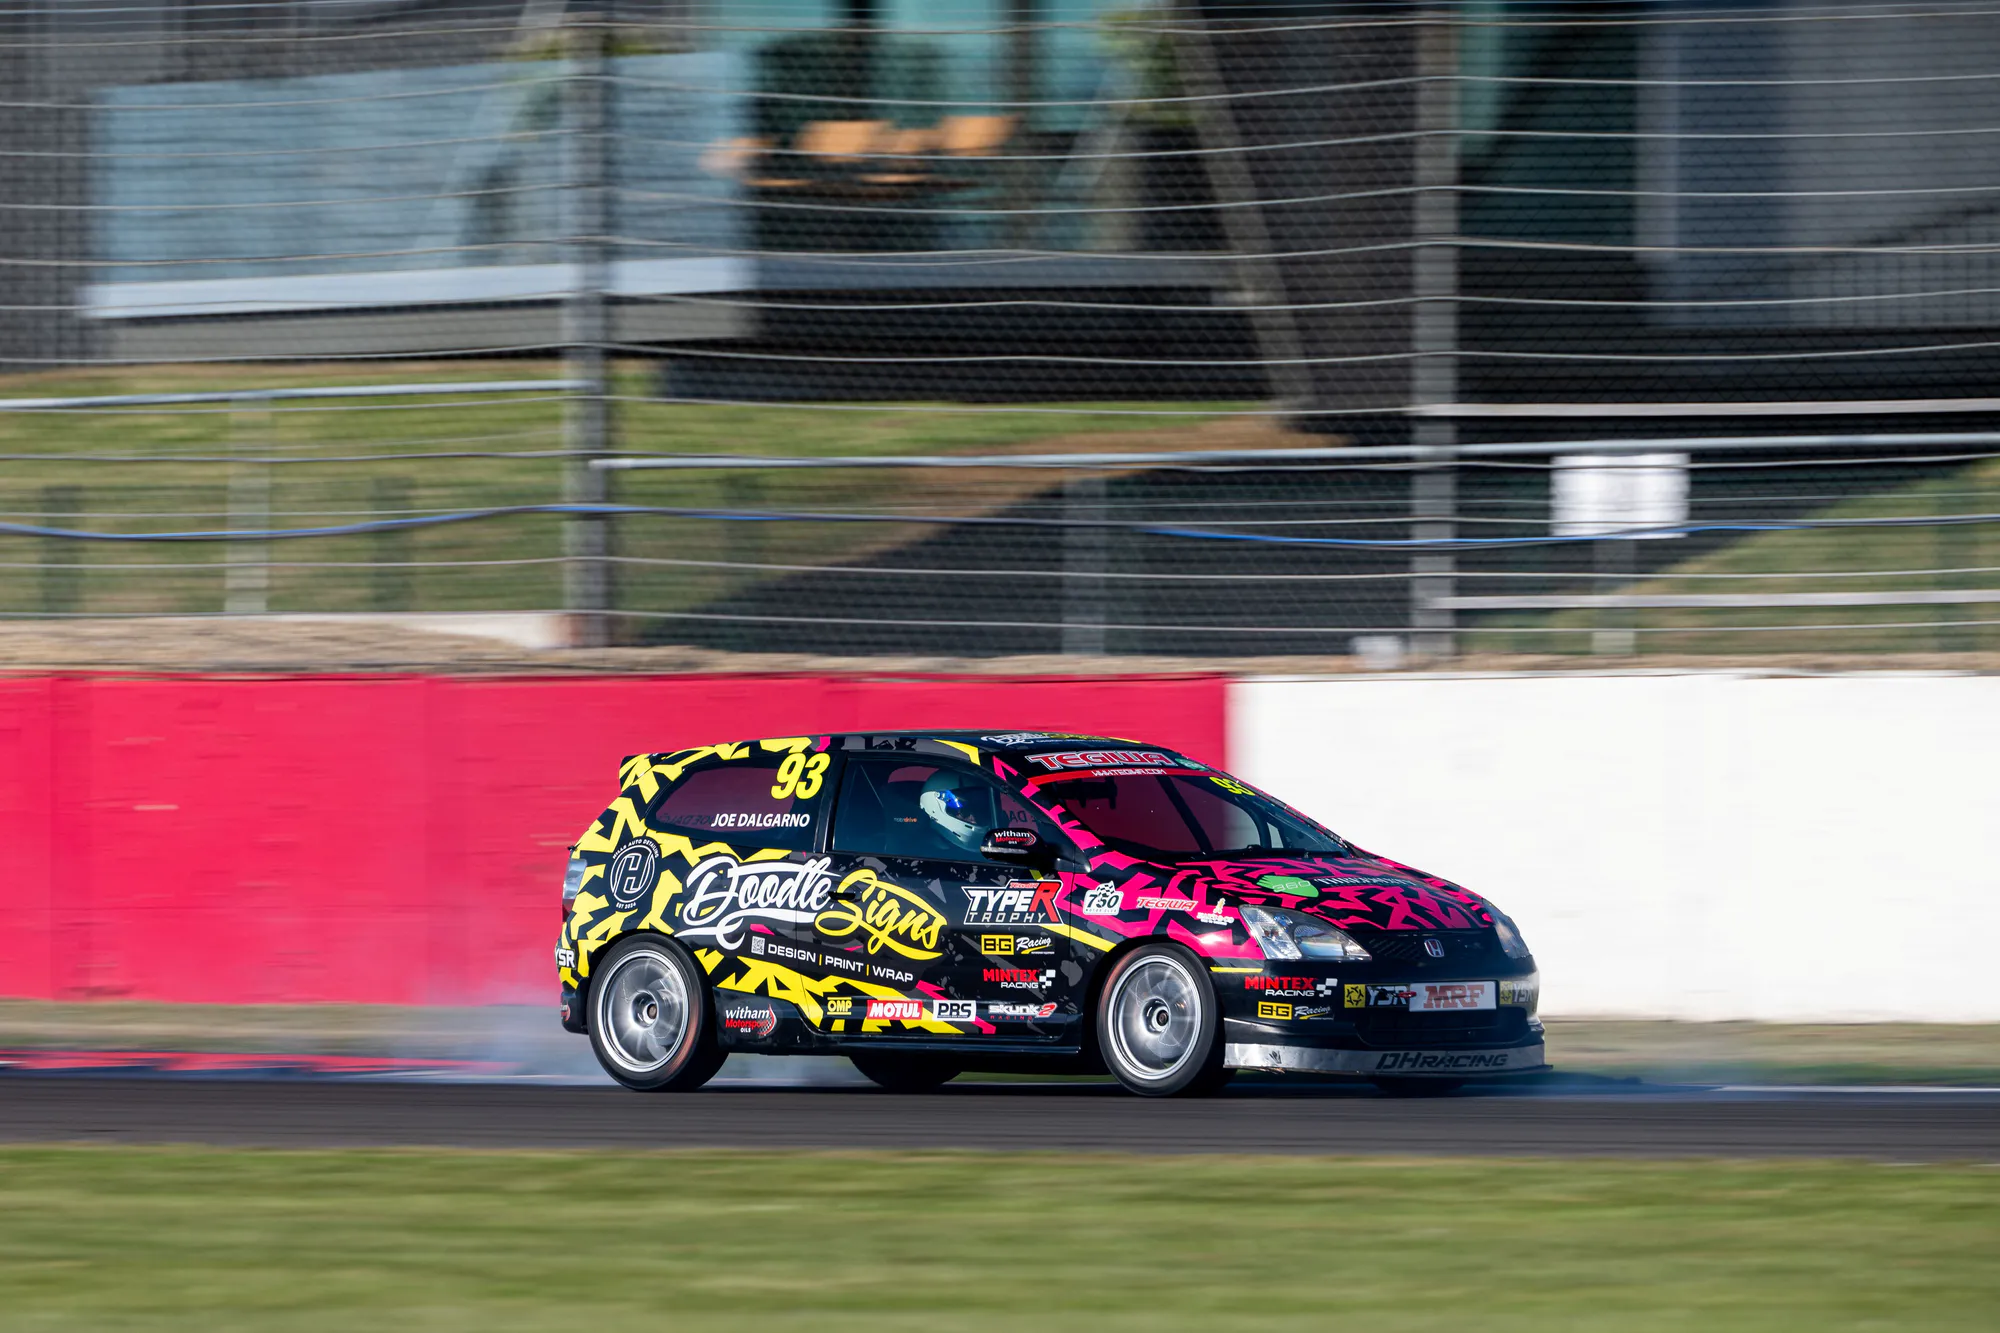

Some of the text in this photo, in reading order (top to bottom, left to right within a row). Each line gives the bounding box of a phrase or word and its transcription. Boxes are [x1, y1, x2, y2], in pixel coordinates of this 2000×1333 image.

[1025, 751, 1177, 770] TEGIWA
[771, 753, 830, 799] 93
[711, 813, 811, 828] JOE DALGARNO
[628, 839, 643, 847] AUTO
[680, 856, 948, 960] Doodle Signs
[1087, 894, 1119, 909] 750
[1137, 898, 1197, 910] TEGIWA
[969, 912, 1046, 922] TROPHY
[1016, 937, 1052, 951] Racing
[768, 944, 914, 983] DESIGN PRINT WRAP
[983, 968, 1039, 982] MINTEX
[1244, 976, 1315, 990] MINTEX
[1265, 989, 1315, 997] RACING
[1366, 986, 1407, 1006] YSR
[1423, 985, 1484, 1009] MRF
[725, 1006, 769, 1019] witham
[827, 1000, 853, 1012] OMP
[869, 1002, 921, 1018] MOTUL
[1294, 1005, 1331, 1017] Racing
[725, 1019, 769, 1030] Motorsport
